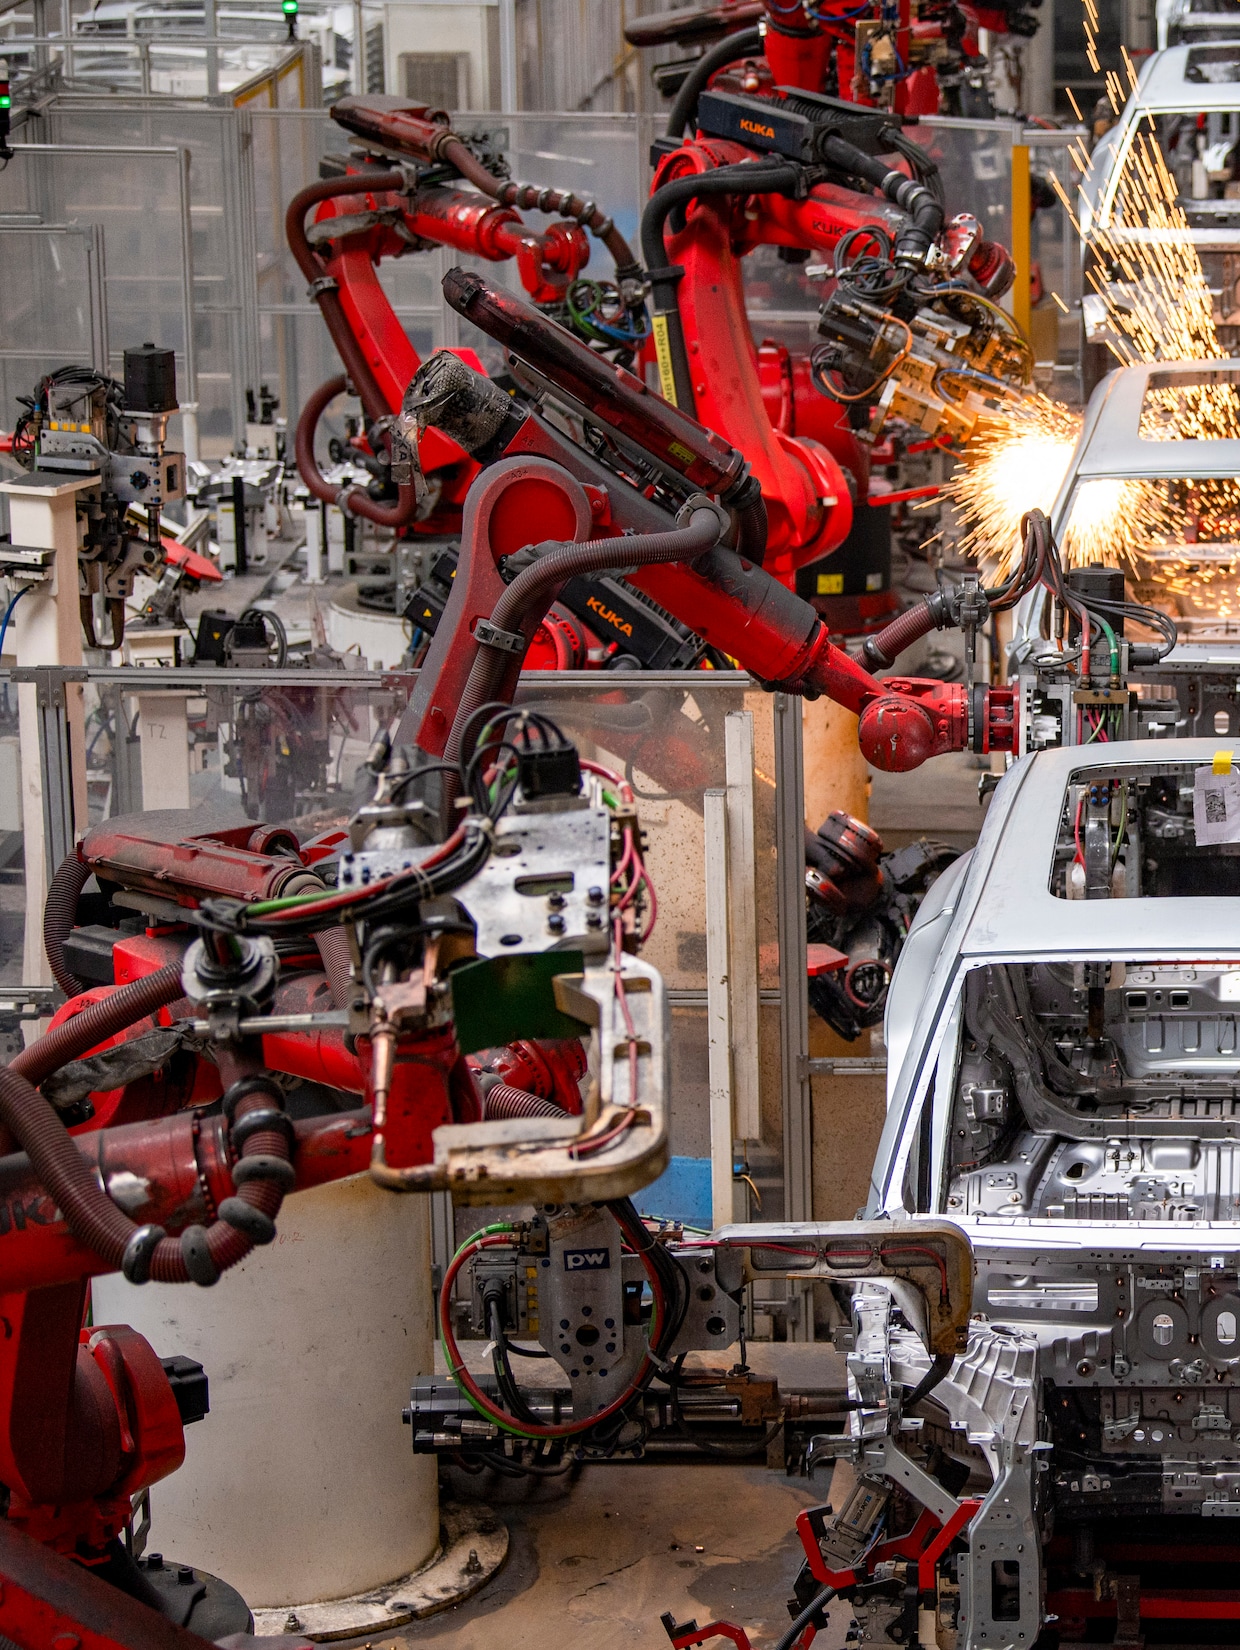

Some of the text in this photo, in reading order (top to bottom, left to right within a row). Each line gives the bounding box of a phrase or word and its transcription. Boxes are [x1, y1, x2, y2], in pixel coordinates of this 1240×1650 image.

[740, 119, 775, 139] KUKA
[812, 220, 853, 238] KUK
[586, 596, 634, 638] KUKA
[566, 1252, 606, 1270] pw
